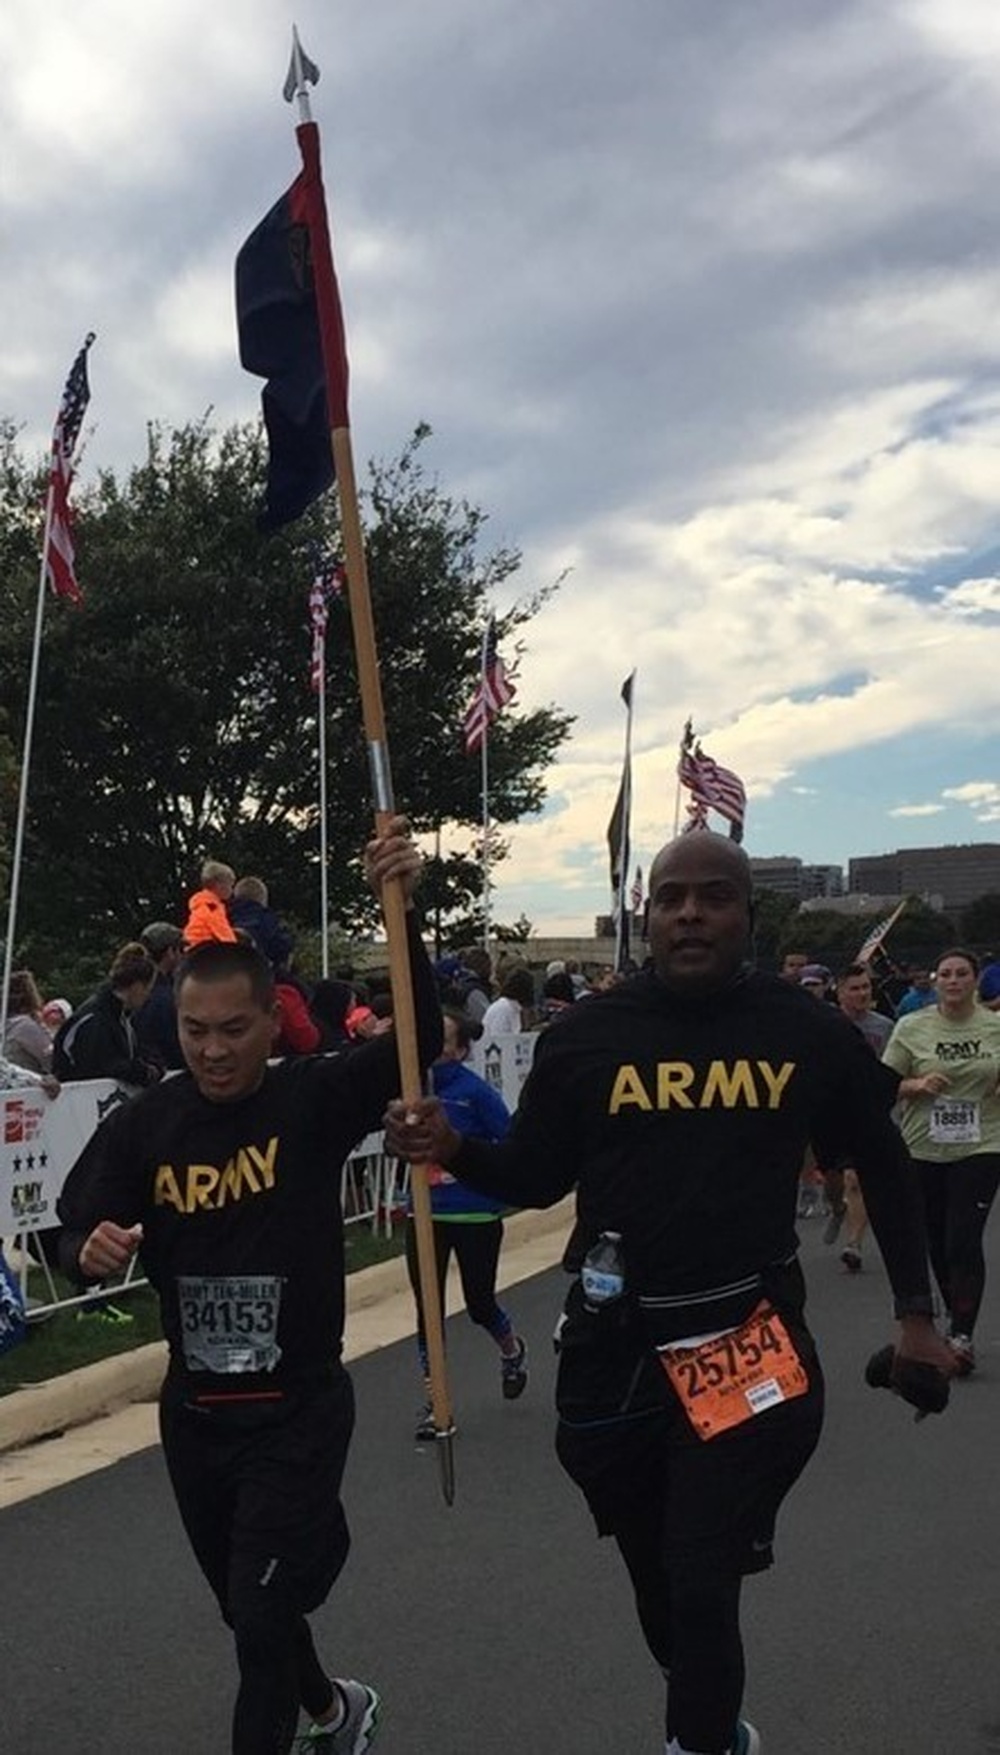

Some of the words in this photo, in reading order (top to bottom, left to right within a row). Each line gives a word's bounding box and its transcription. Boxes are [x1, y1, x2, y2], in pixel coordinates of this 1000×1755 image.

[935, 1040, 981, 1054] ARMY
[608, 1060, 796, 1115] ARMY
[155, 1136, 278, 1213] ARMY
[184, 1301, 273, 1332] 34153
[677, 1324, 782, 1397] 25754
